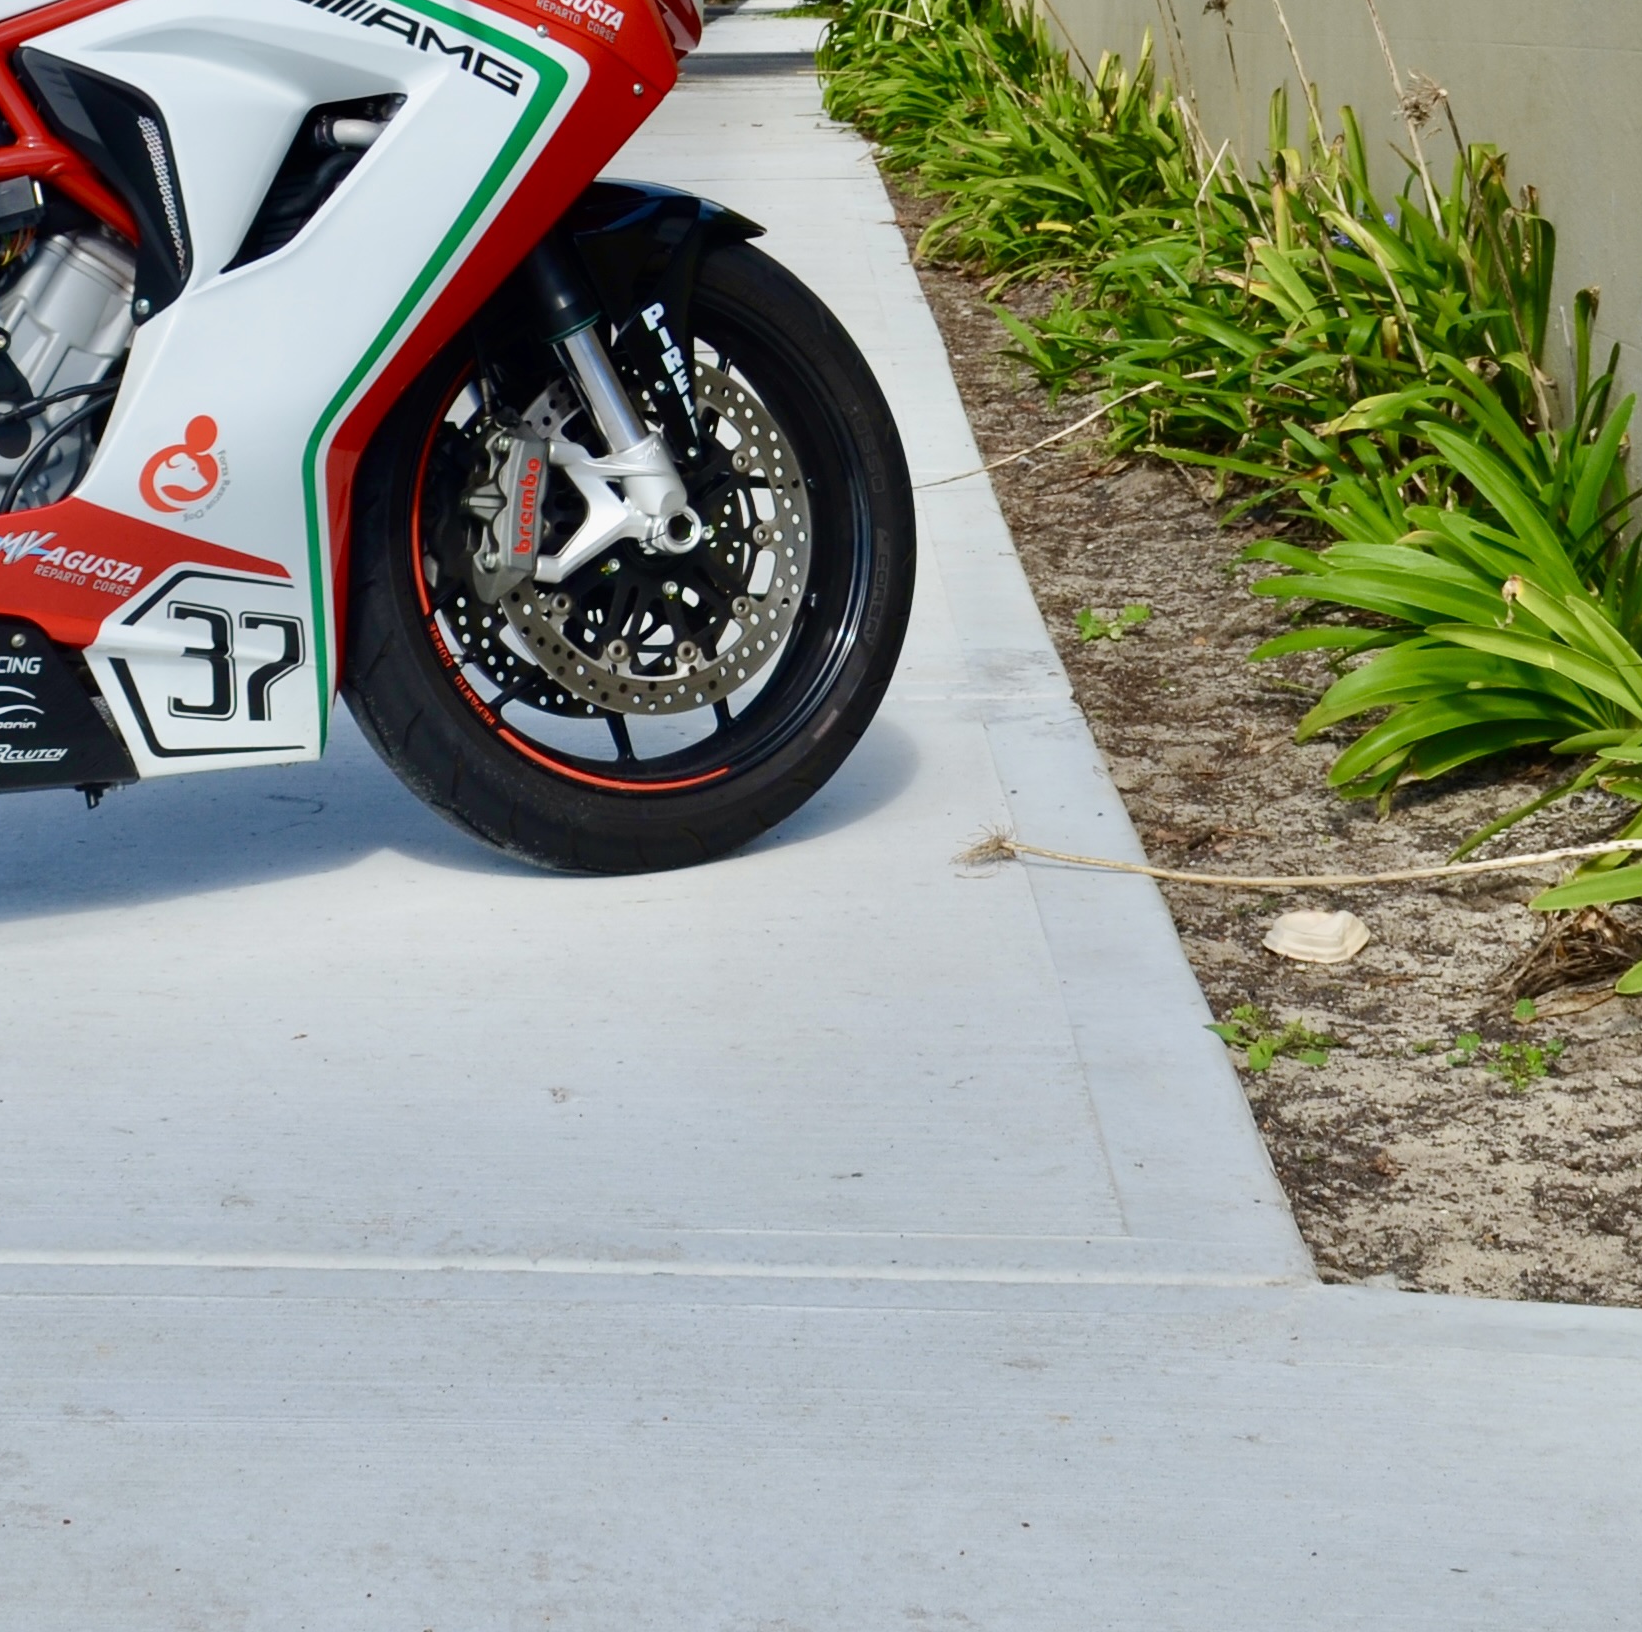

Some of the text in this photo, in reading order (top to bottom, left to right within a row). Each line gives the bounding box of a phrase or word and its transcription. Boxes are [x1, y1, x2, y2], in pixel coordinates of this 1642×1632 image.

[360, 7, 523, 97] AMG
[587, 20, 617, 44] CORSE
[514, 458, 541, 554] brembo
[33, 564, 132, 598] REPARTO CORSE
[41, 545, 144, 586] AGUSTA
[167, 600, 307, 722] 37
[454, 674, 497, 727] REPARTO
